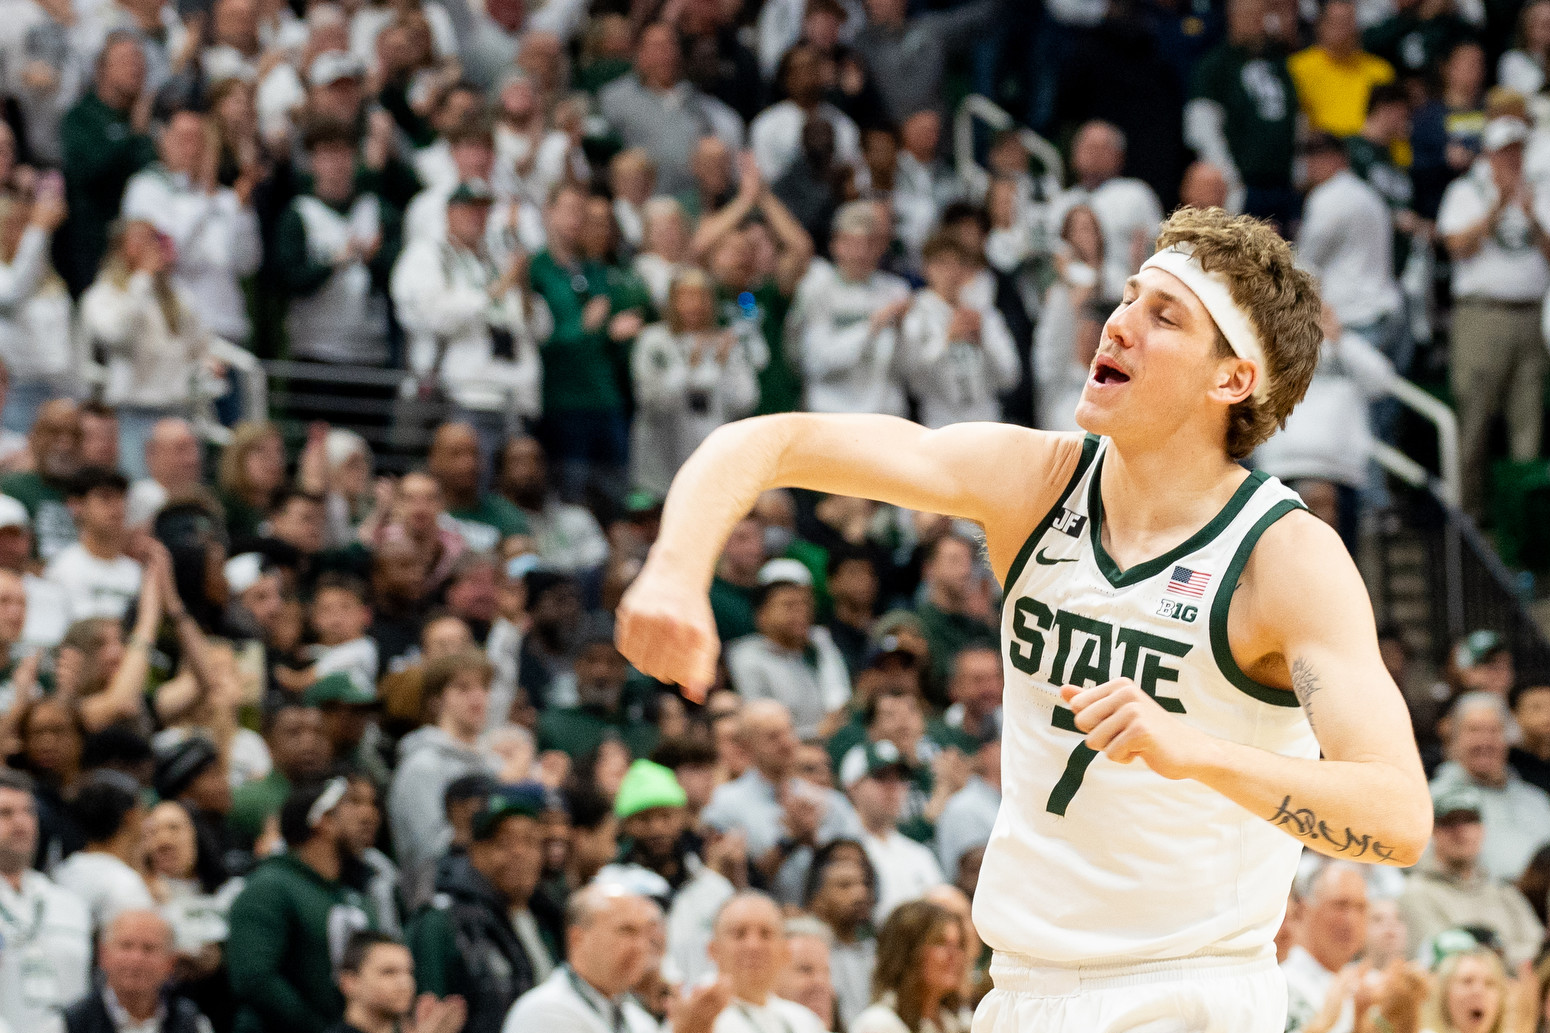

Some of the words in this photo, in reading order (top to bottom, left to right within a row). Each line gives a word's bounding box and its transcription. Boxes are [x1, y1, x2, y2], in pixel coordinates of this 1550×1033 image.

[1052, 508, 1082, 533] JF
[1009, 596, 1194, 714] STATE
[1045, 704, 1107, 817] 7
